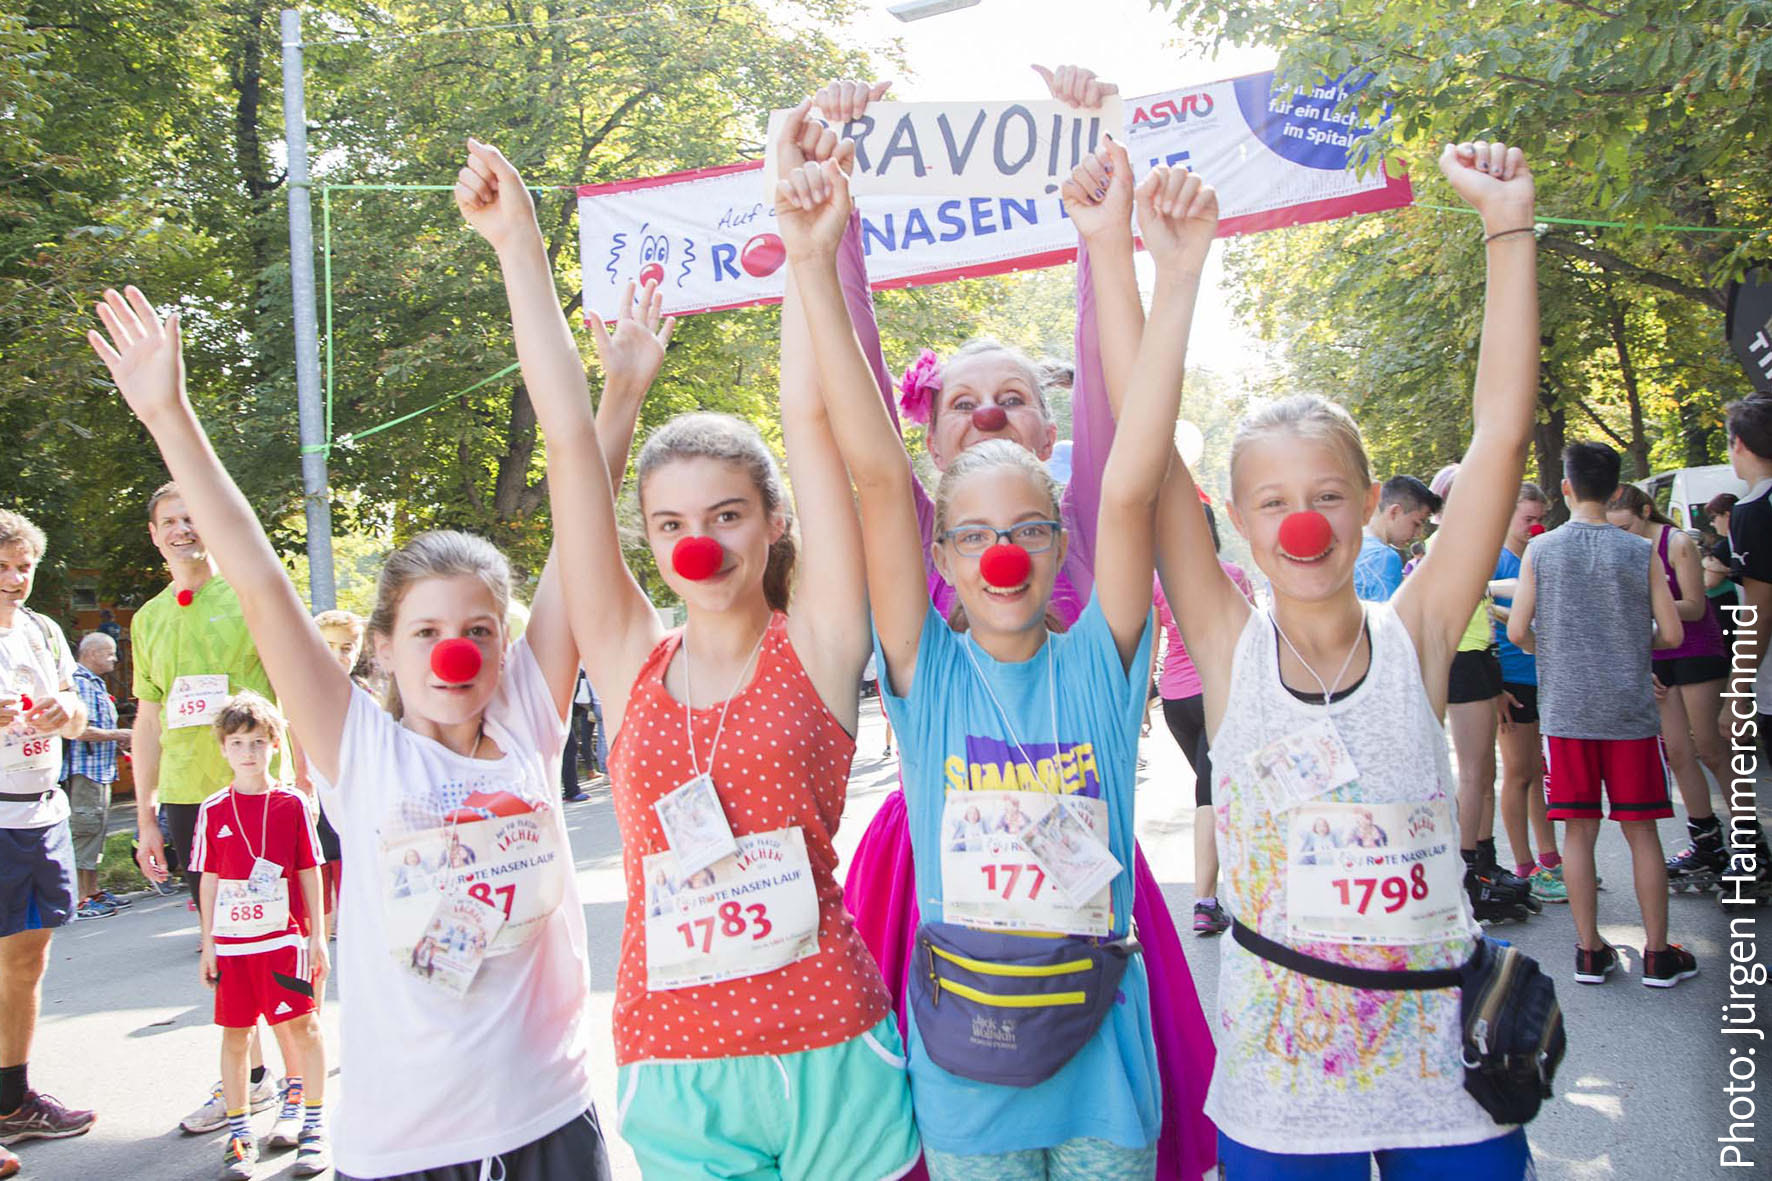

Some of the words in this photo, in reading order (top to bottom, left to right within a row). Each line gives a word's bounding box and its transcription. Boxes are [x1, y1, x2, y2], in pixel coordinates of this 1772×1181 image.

[1295, 104, 1320, 120] ein
[1283, 122, 1304, 139] im
[815, 103, 1100, 194] RAVO!!!
[716, 203, 763, 230] Auf
[861, 196, 1039, 257] NASEN
[23, 740, 50, 757] 686
[490, 860, 529, 877] NASEN
[731, 878, 771, 898] NASEN
[980, 864, 1058, 901] 177
[1331, 862, 1429, 916] 1798
[230, 904, 264, 922] 688
[676, 900, 773, 954] 1783
